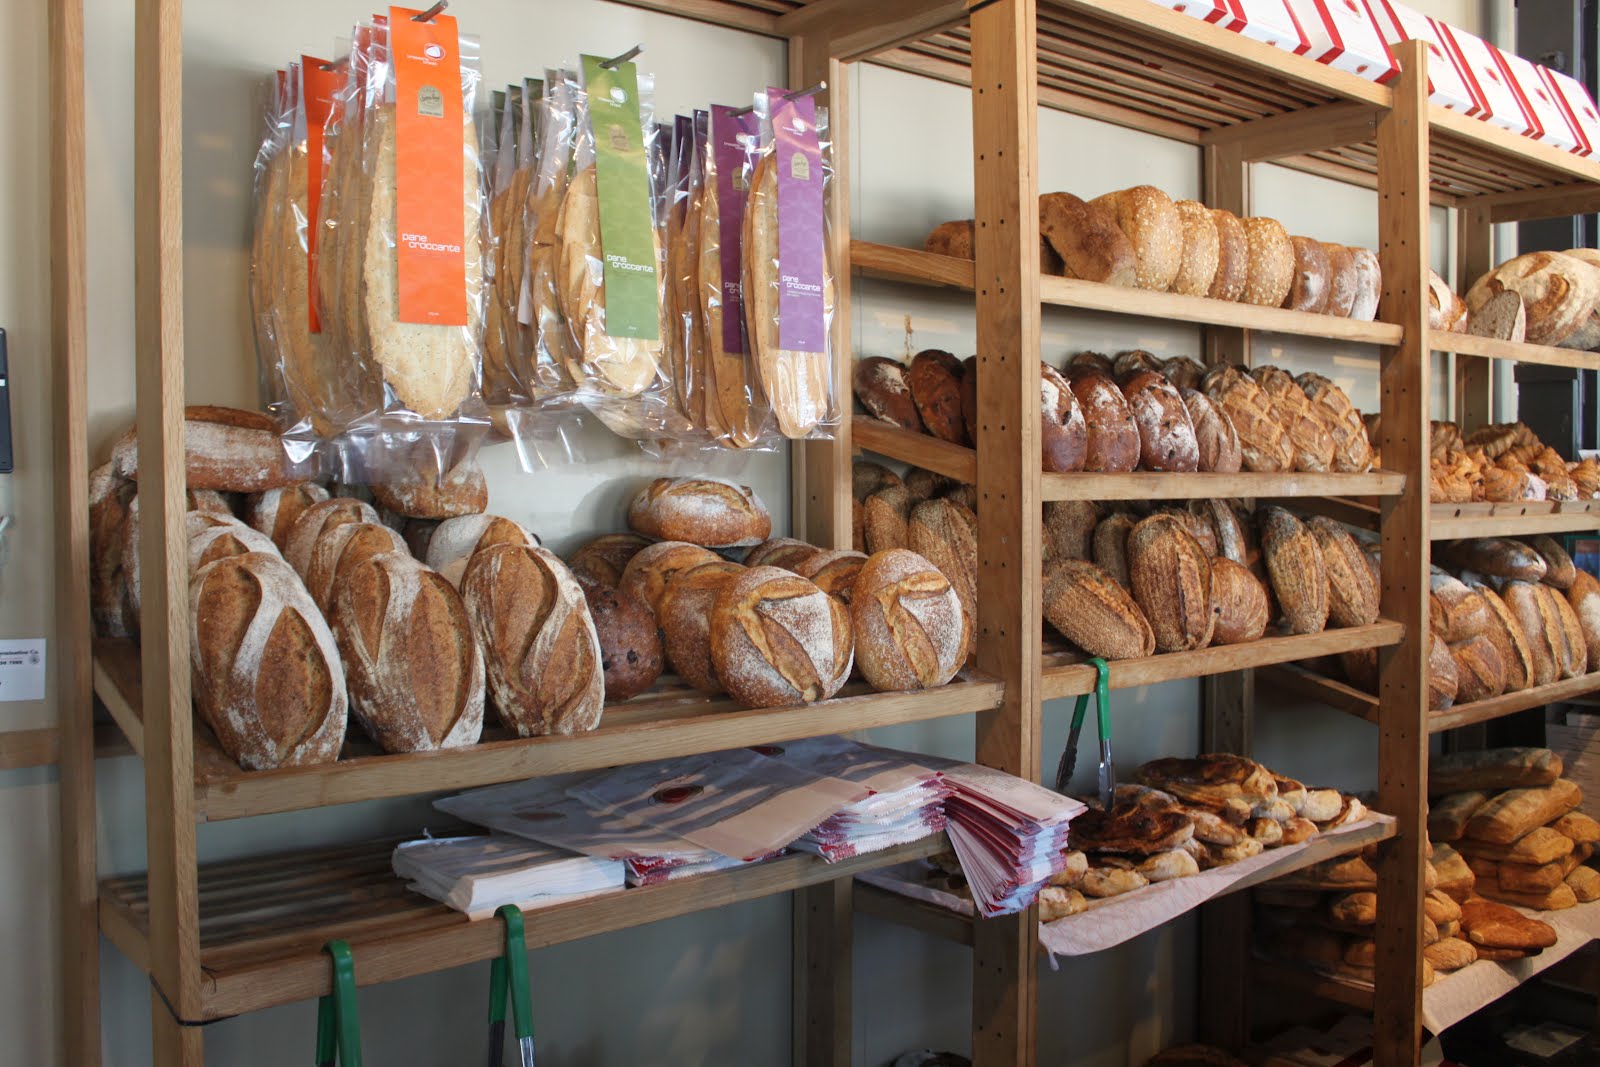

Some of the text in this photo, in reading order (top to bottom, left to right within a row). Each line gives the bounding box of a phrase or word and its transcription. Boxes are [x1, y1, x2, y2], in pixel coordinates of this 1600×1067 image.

[402, 233, 427, 242] pane
[408, 241, 461, 253] croccante
[606, 254, 627, 263] pane
[612, 261, 654, 273] croccante
[782, 275, 799, 283] pane
[724, 281, 741, 289] pan
[786, 282, 821, 292] croccante
